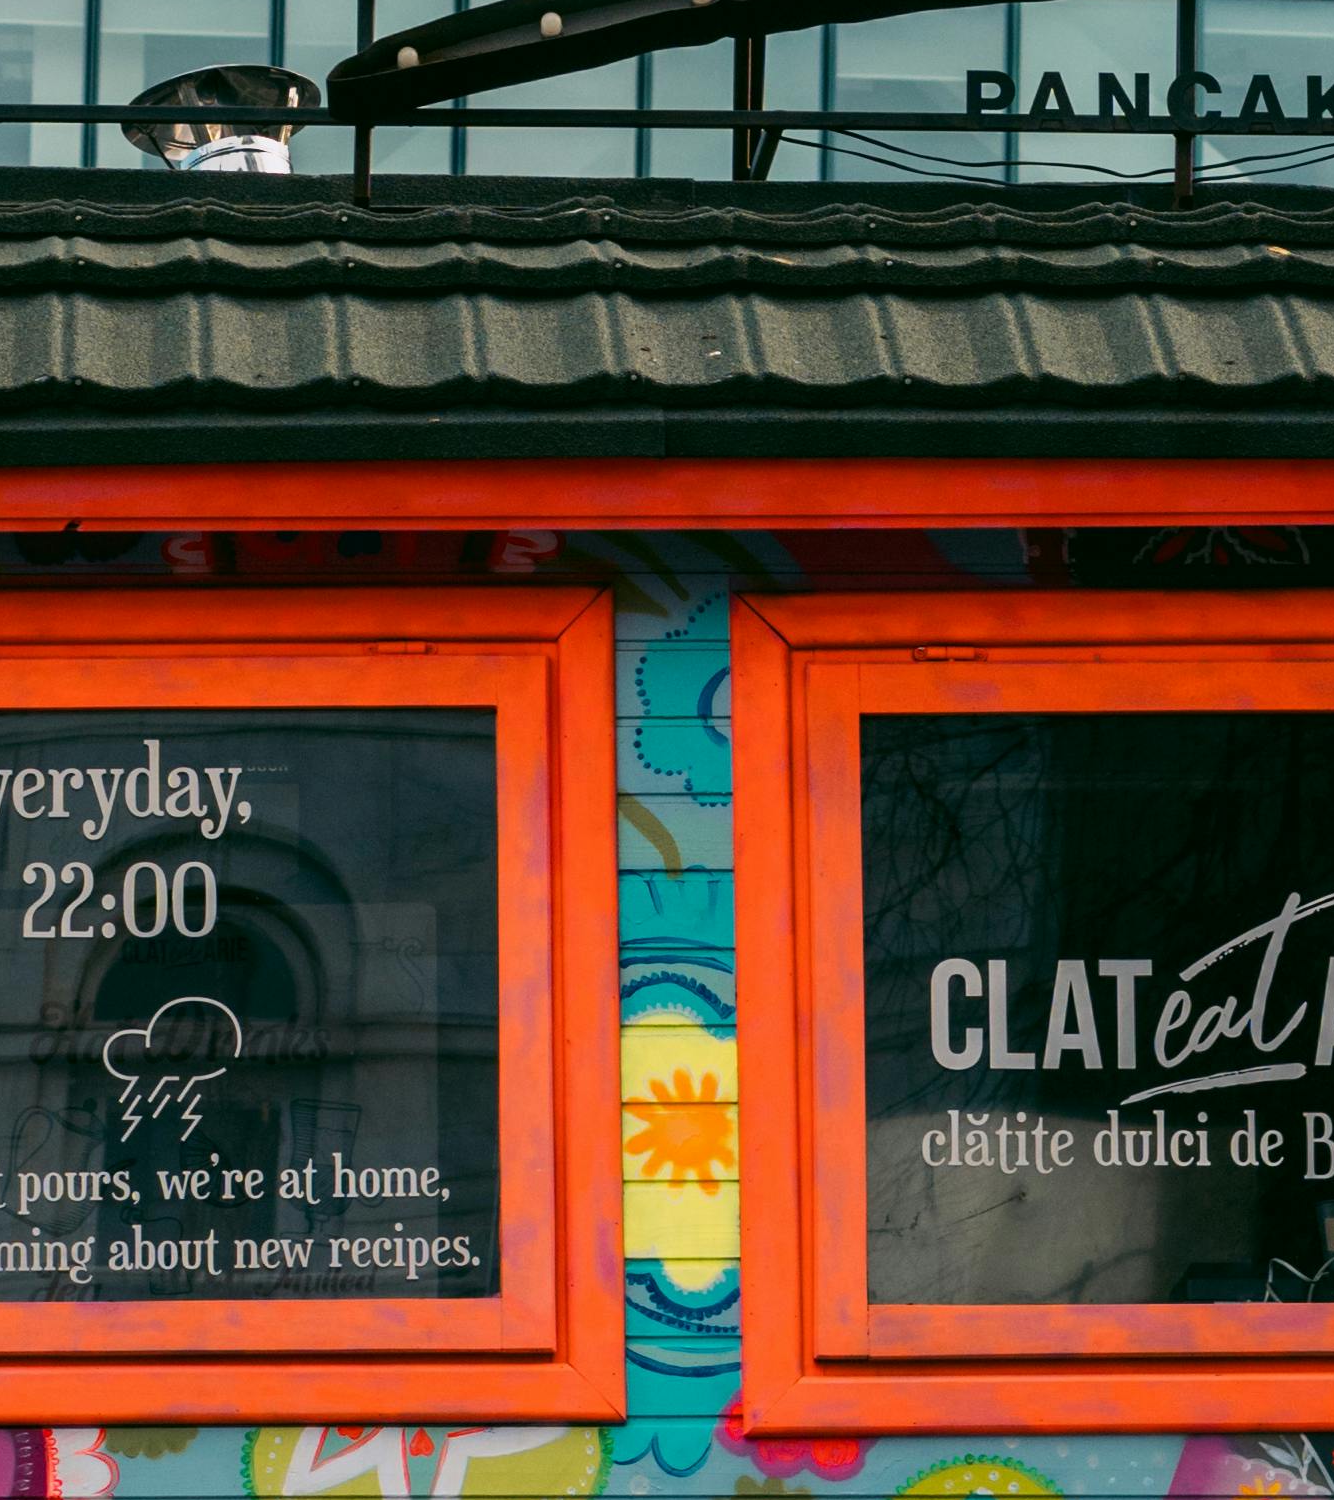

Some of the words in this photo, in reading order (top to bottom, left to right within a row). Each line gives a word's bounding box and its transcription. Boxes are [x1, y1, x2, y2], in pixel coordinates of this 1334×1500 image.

[23, 862, 216, 938] 22:00
[1094, 1110, 1211, 1166] dulci
[1231, 1110, 1283, 1166] de
[18, 1171, 140, 1215] pours,
[157, 1153, 264, 1199] we're
[279, 1158, 320, 1204] at
[332, 1153, 449, 1201] home,
[109, 1225, 222, 1275] about
[234, 1239, 314, 1268] new
[329, 1223, 480, 1279] recipes.
